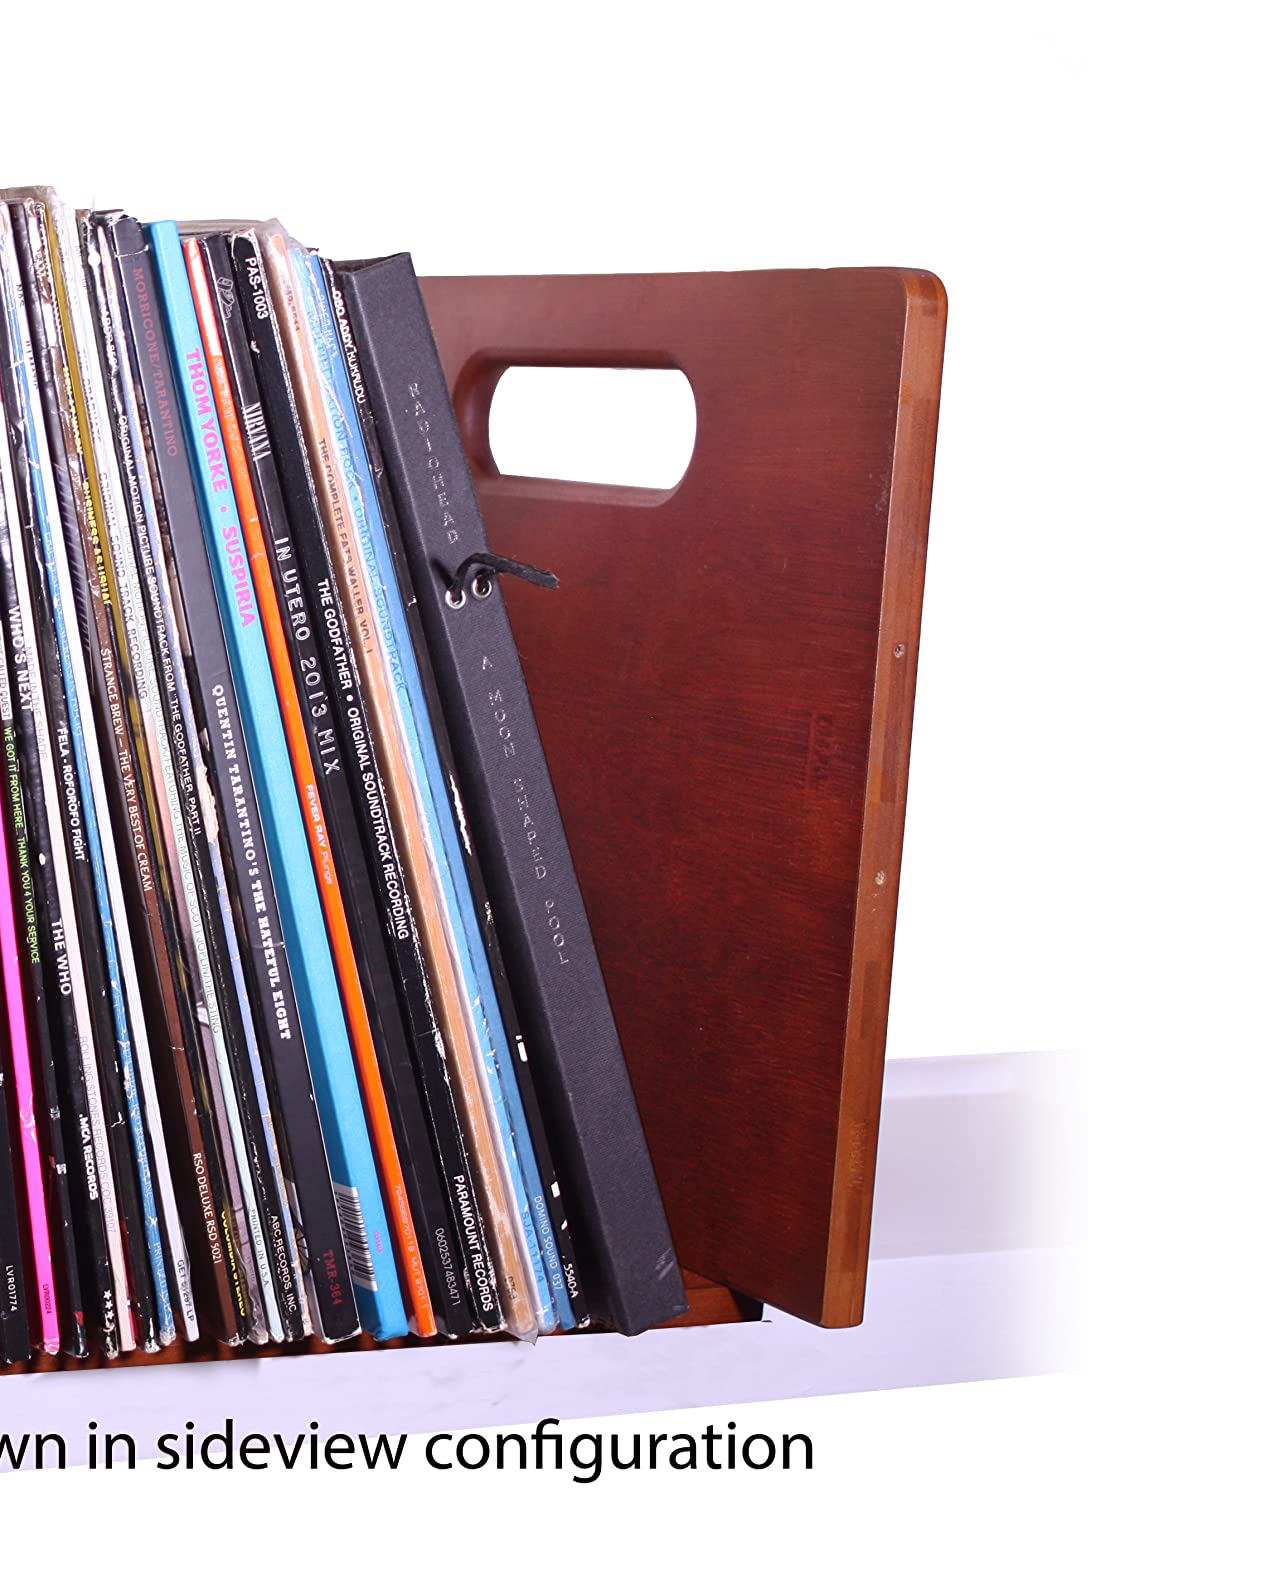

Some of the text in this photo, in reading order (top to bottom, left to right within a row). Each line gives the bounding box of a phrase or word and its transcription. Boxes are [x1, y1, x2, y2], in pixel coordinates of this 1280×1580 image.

[243, 257, 269, 319] PAS-1003
[130, 268, 181, 456] MORRICONE/TARANTINO
[239, 401, 273, 460] NIRVANA
[406, 382, 460, 544] RADIOHEAD
[182, 347, 214, 414] THOM
[198, 418, 230, 491] YORKE
[220, 526, 258, 626] SUSPIRIA
[8, 606, 32, 711] WHO'S NEXT
[128, 478, 201, 825] MOTION PICTURE SOUNDTRACK FROM PART
[271, 537, 340, 774] IN UTERO 2013 MIX
[0, 691, 10, 718] QUEST
[3, 727, 13, 740] WE
[5, 743, 16, 762] GOT
[9, 774, 20, 801] FROM
[99, 648, 152, 891] STRANGE BREW THE VERY BEST OF CREAM
[315, 578, 410, 939] THE GODFATHER ORIGINAL SOUNDTRACK RECORDING
[56, 728, 85, 859] FELA ROFOROFO FIGHT
[304, 784, 326, 847] FEVER RAY
[486, 689, 570, 964] MOON SHAPED POOL
[16, 837, 28, 867] THANK
[20, 870, 31, 889] YOU
[210, 684, 292, 1039] QUENTIN TARANTINO'S THE HATEFUL EIGHT
[23, 898, 35, 922] YOUR
[26, 926, 40, 963] SERVICE
[50, 918, 71, 994] THE WHO
[77, 1037, 111, 1203] ROLLING STONES RECORDS COC
[82, 1146, 98, 1199] RECORDS
[191, 1152, 221, 1263] RSO DELUXE RSD 5021
[269, 1215, 283, 1236] ABC
[452, 1175, 494, 1311] PARAMOUNT RECORDS
[532, 1195, 563, 1289] DOMINO SOUND 037
[4, 1265, 18, 1310] LVR01774
[321, 1249, 343, 1304] TMR-364
[433, 1227, 461, 1305] 0602537483471
[562, 1263, 579, 1297] 5540-A
